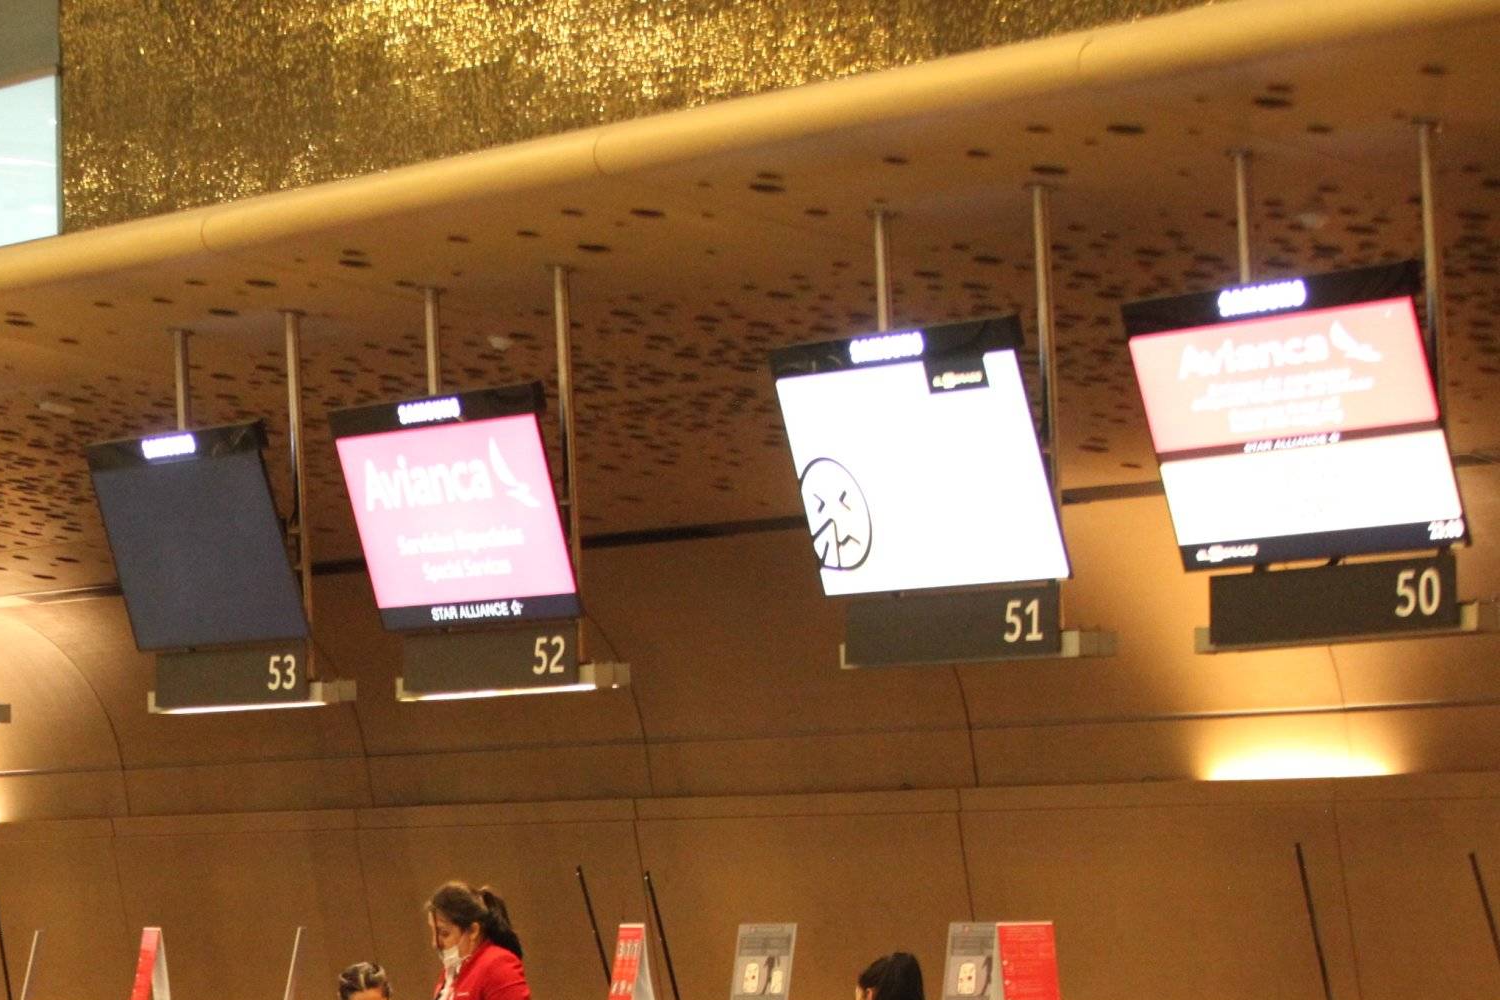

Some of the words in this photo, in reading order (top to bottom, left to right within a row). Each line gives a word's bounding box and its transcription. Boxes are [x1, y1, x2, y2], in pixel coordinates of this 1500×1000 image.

[1178, 333, 1329, 380] Avianca
[364, 454, 493, 512] Avianca
[431, 604, 459, 622] STAR
[460, 602, 509, 619] ALLIANCE
[1395, 567, 1441, 618] 50
[1003, 598, 1043, 643] 51
[267, 654, 297, 691] 53
[532, 635, 565, 675] 52
